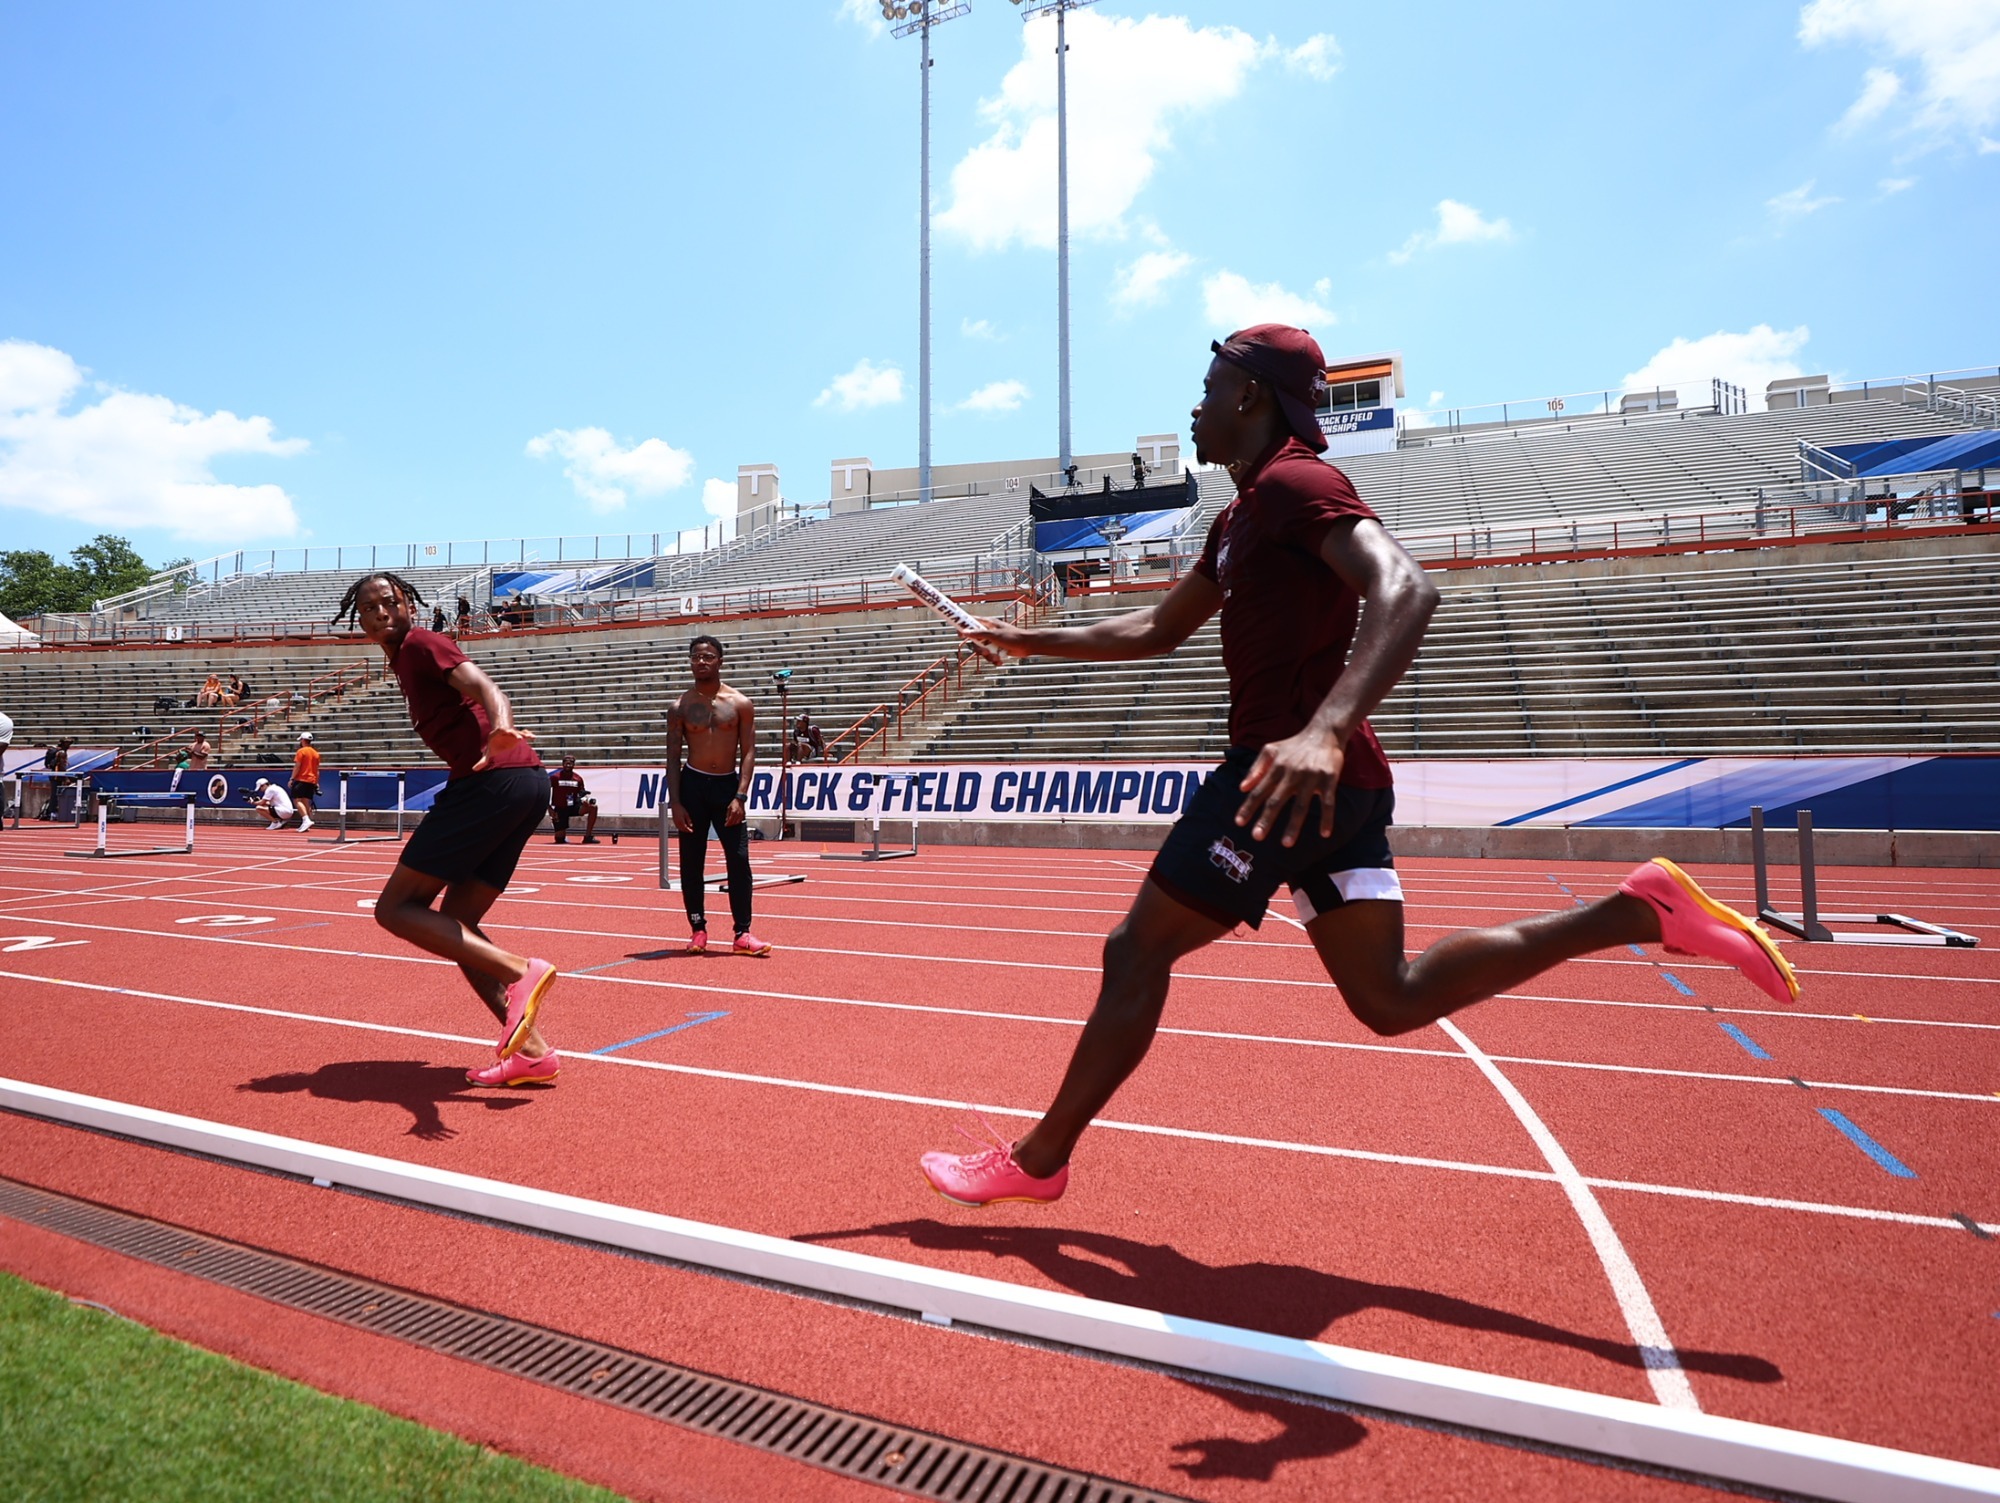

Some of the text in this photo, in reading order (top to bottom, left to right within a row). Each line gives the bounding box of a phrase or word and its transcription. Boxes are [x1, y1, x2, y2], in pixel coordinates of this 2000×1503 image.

[1547, 400, 1564, 411] 105
[1316, 415, 1341, 426] RACK
[1350, 411, 1373, 423] FIELD
[1319, 422, 1358, 435] ONSHIPS
[1006, 478, 1018, 488] 104
[425, 545, 437, 556] 103
[685, 597, 694, 612] 4
[171, 627, 178, 639] 3
[749, 772, 840, 811] RACK
[848, 772, 875, 811] &
[881, 771, 982, 812] FIELD
[1217, 846, 1244, 872] STATE
[174, 914, 277, 927] 3
[0, 935, 92, 952] 2
